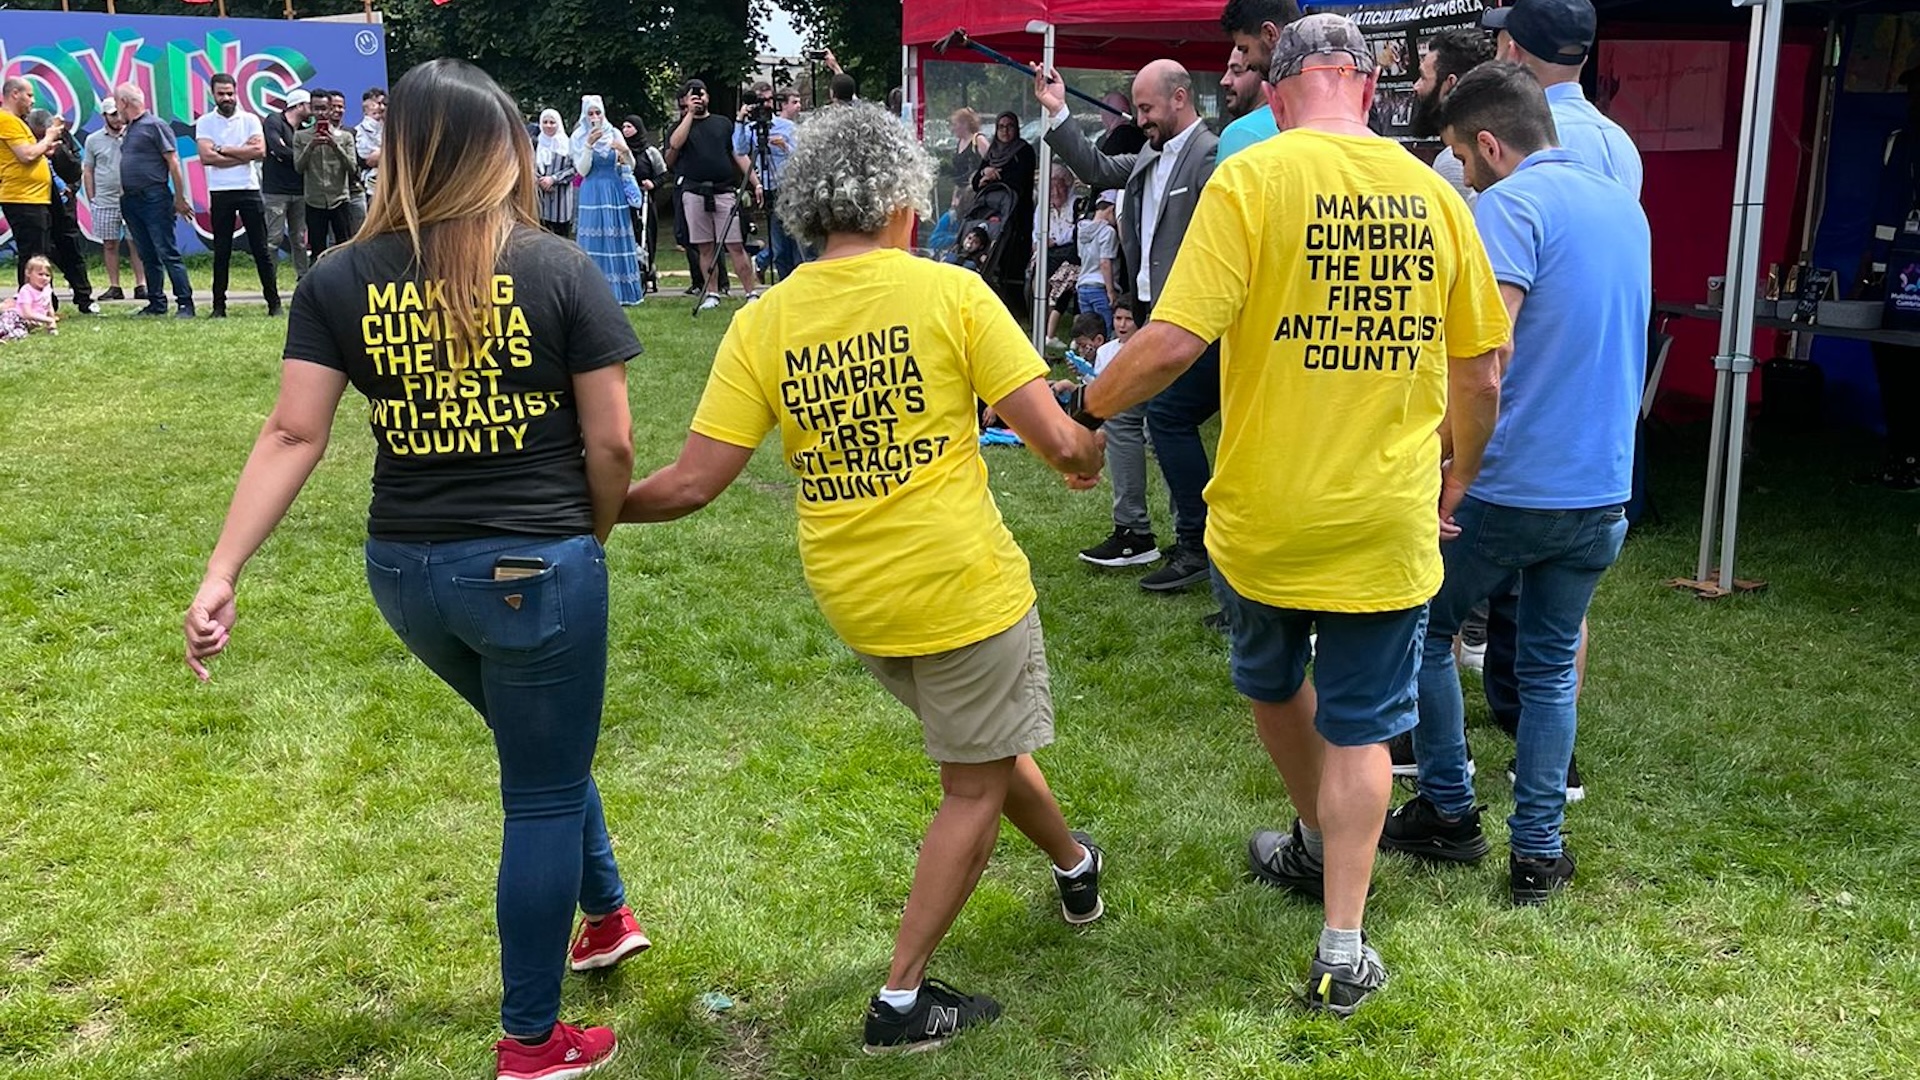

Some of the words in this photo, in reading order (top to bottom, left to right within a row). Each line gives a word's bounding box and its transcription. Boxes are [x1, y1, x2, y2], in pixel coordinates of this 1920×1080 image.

[1424, 0, 1483, 19] CUMBRIA
[1316, 193, 1427, 220] MAKING
[1305, 223, 1434, 251] CUMBRIA
[1306, 254, 1360, 281] THE
[1371, 254, 1434, 281] UK'S
[1328, 285, 1412, 311] FIRST
[366, 342, 435, 375] THE
[784, 325, 910, 377] MAKING
[1304, 344, 1421, 371] COUNTY
[401, 368, 503, 401] FIRST
[781, 355, 924, 408] CUMBRIA
[371, 391, 564, 429] NTI-RACIST
[852, 385, 926, 420] UK'S
[386, 422, 529, 455] COUNTY
